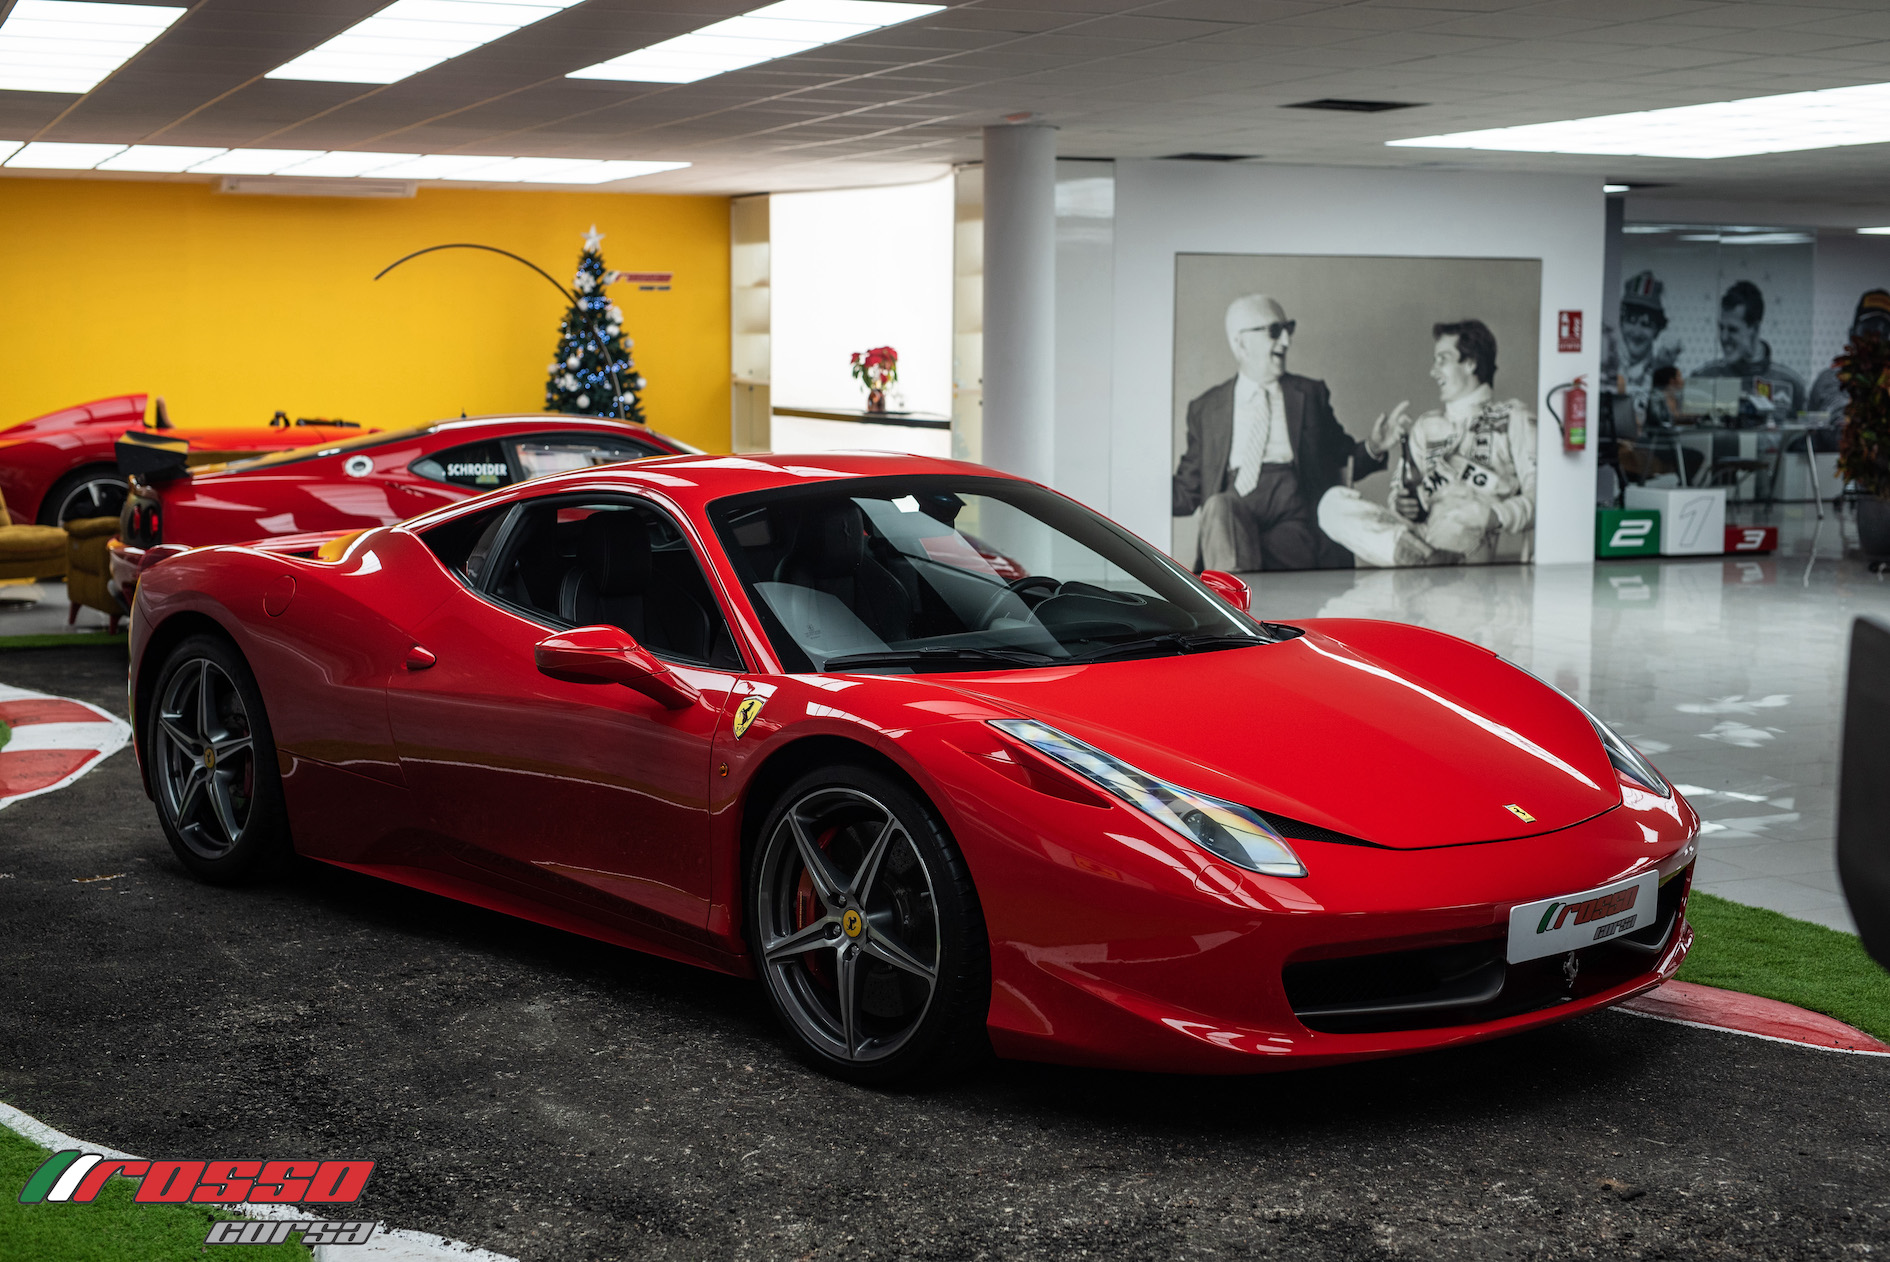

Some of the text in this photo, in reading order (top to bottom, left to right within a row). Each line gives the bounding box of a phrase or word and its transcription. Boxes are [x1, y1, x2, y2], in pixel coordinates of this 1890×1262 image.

[447, 463, 507, 476] SCHROEDER
[1609, 519, 1653, 547] 2
[1679, 495, 1716, 548] 1
[1735, 529, 1766, 549] 3
